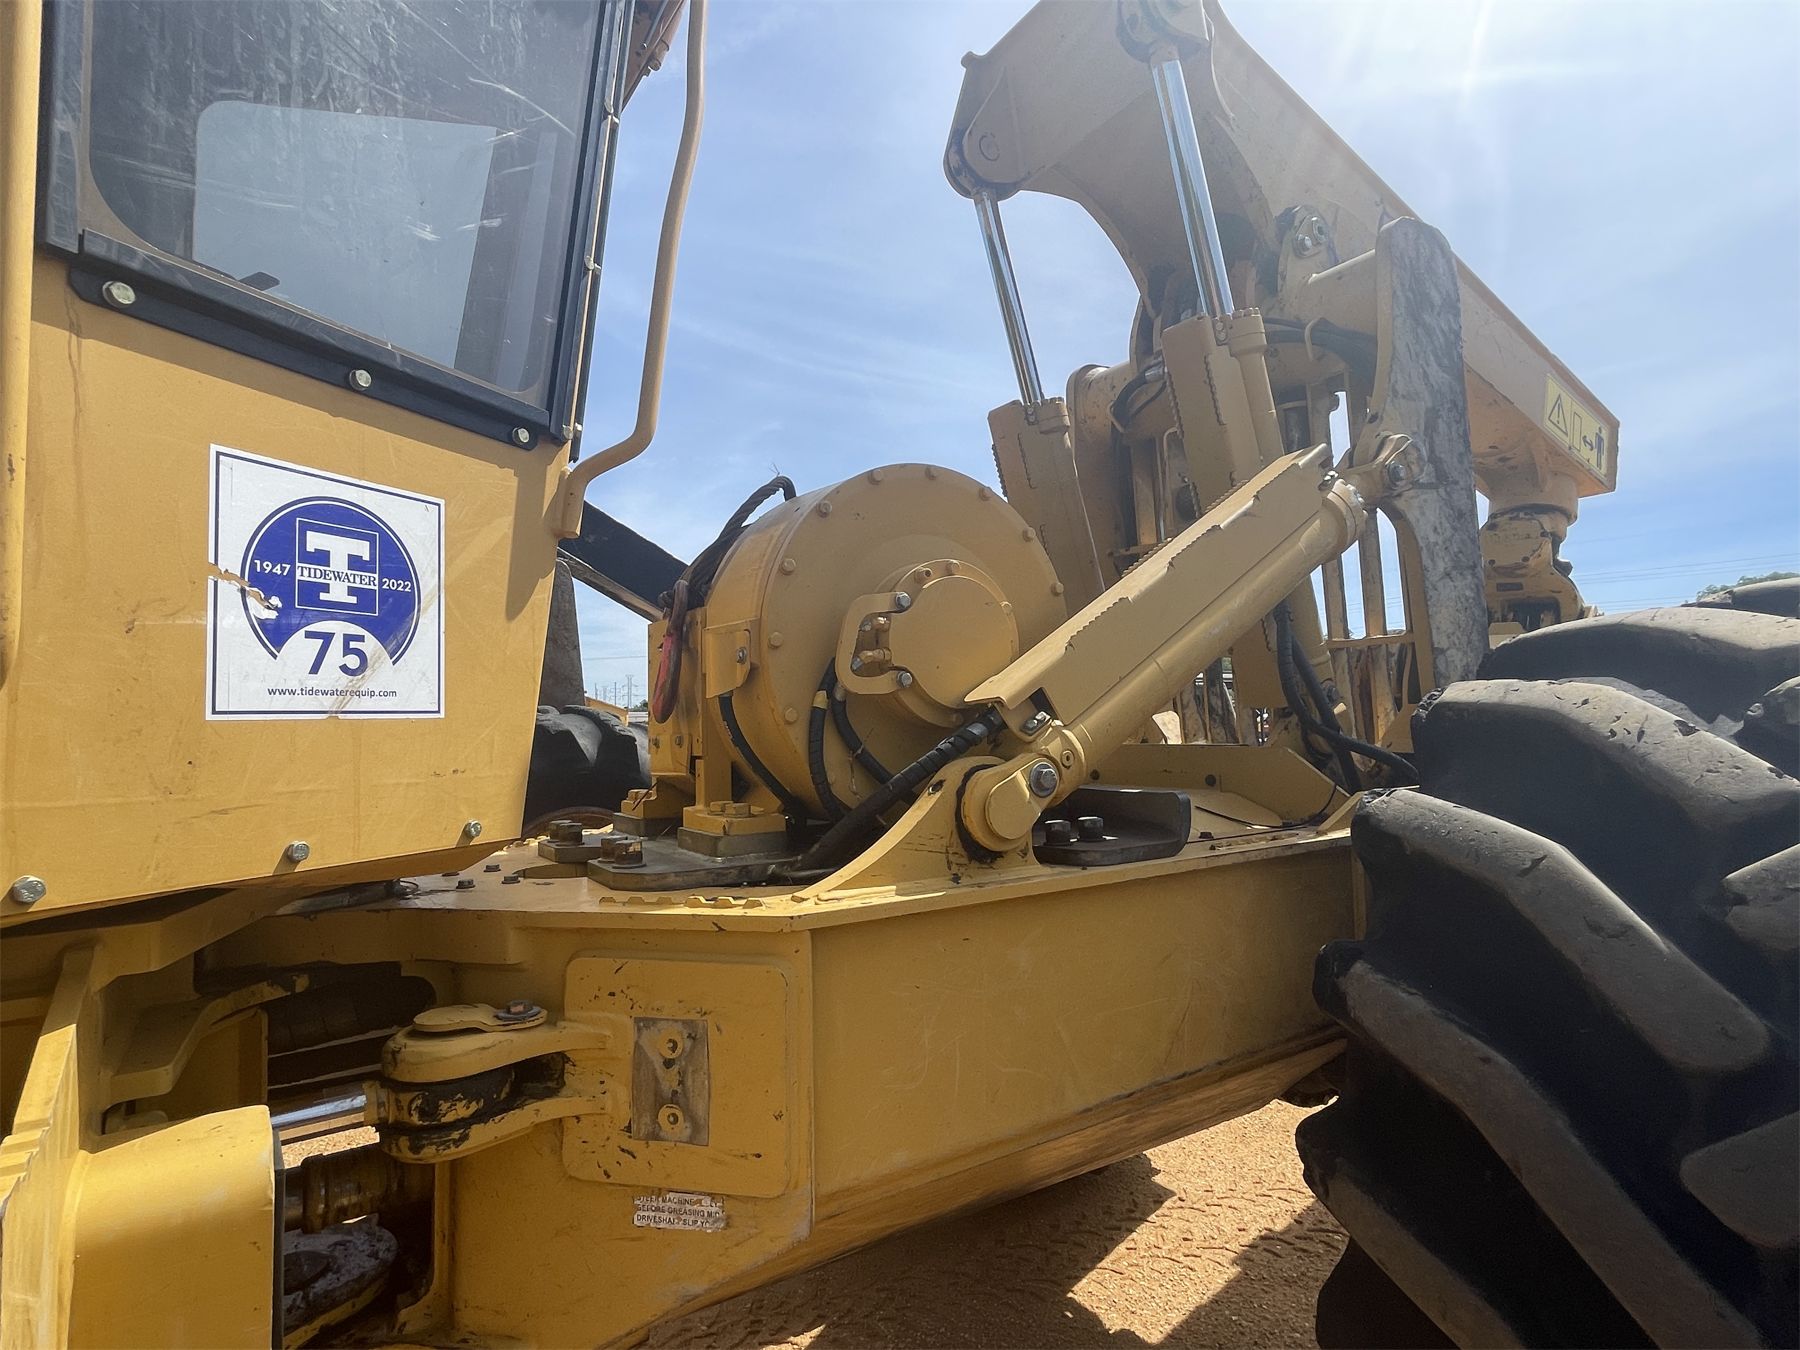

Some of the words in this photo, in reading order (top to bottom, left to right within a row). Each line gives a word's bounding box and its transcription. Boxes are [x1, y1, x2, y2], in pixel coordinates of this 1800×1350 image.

[253, 559, 291, 576] 1947
[297, 566, 377, 587] TIDEWATER
[382, 578, 412, 592] 2022
[306, 530, 370, 603] T
[304, 630, 368, 677] 75
[267, 686, 397, 699] www.tidewaterequip.com
[667, 1206, 705, 1218] GREASING
[683, 1218, 699, 1227] SLIP
